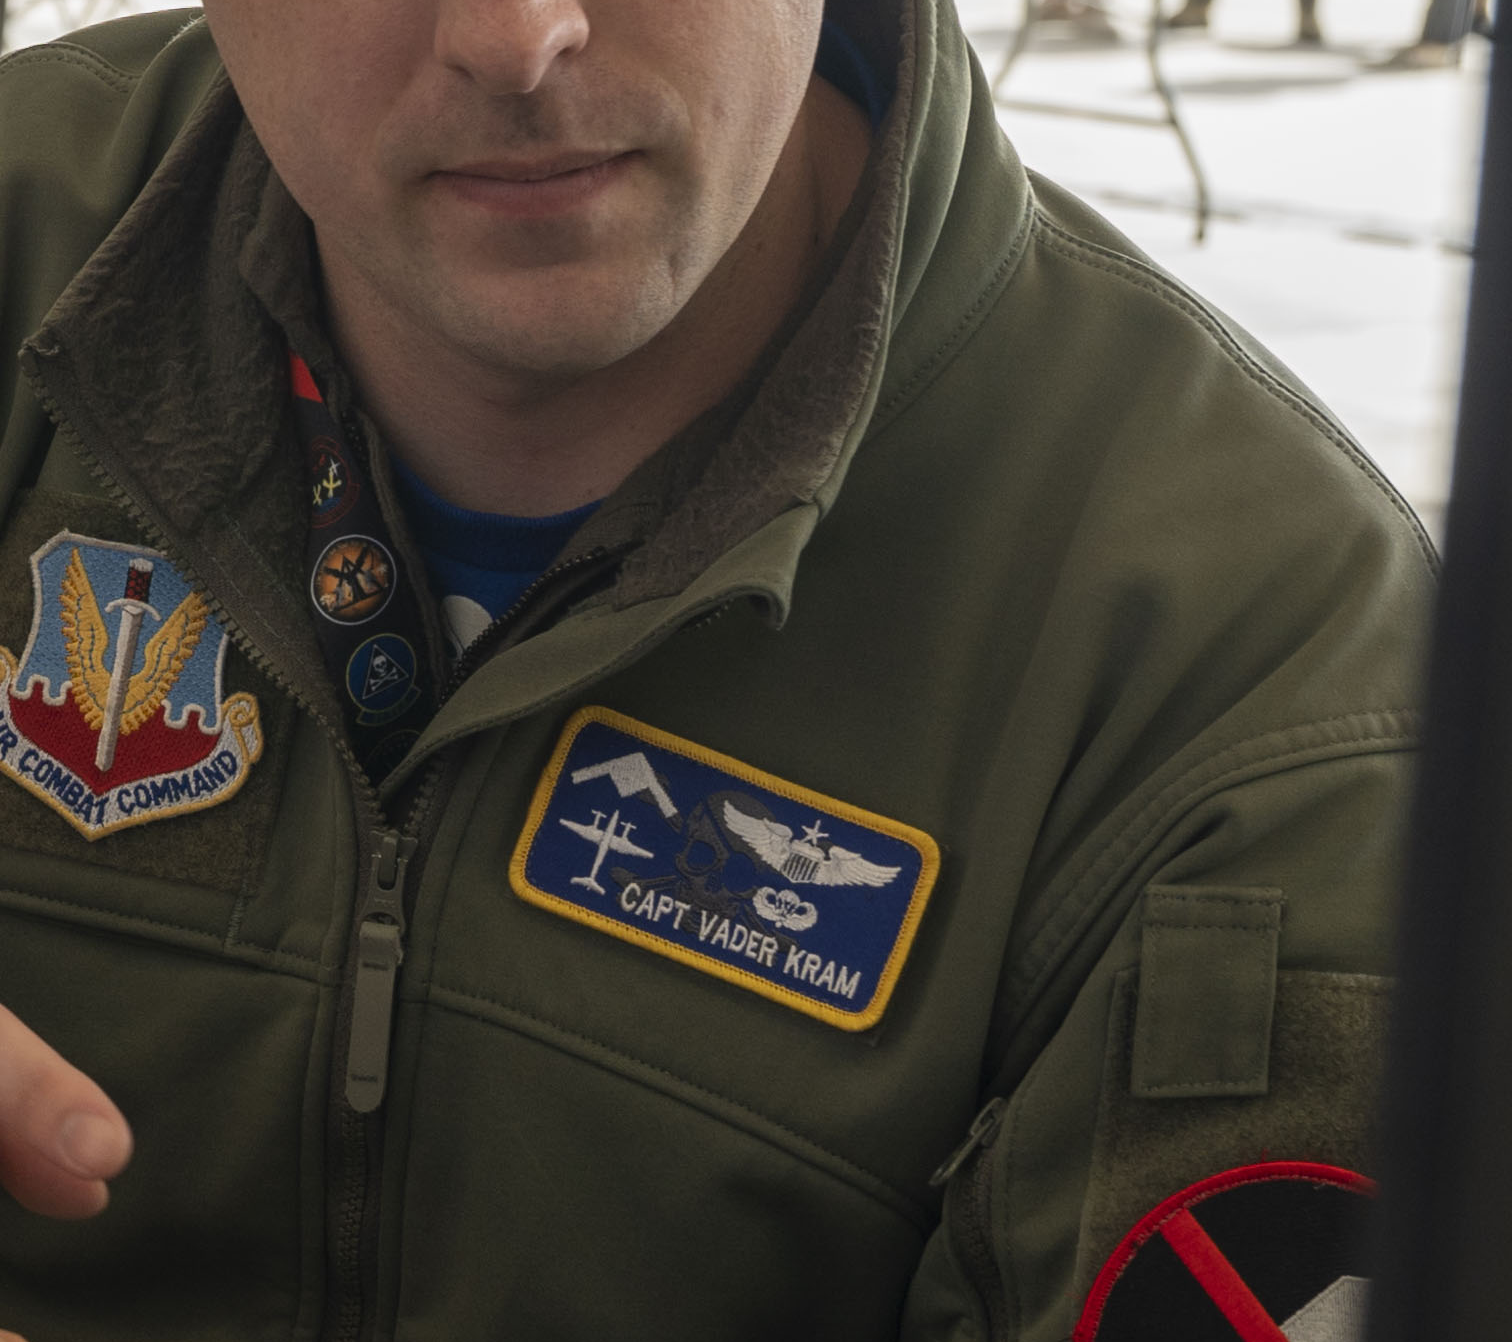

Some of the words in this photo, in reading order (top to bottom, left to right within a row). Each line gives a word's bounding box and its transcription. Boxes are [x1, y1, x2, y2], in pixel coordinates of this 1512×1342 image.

[19, 748, 109, 828] COMBAT
[116, 749, 239, 815] COMMAND
[619, 881, 692, 932] CAPT
[698, 909, 780, 969] VADER
[782, 944, 863, 1000] KRAM
